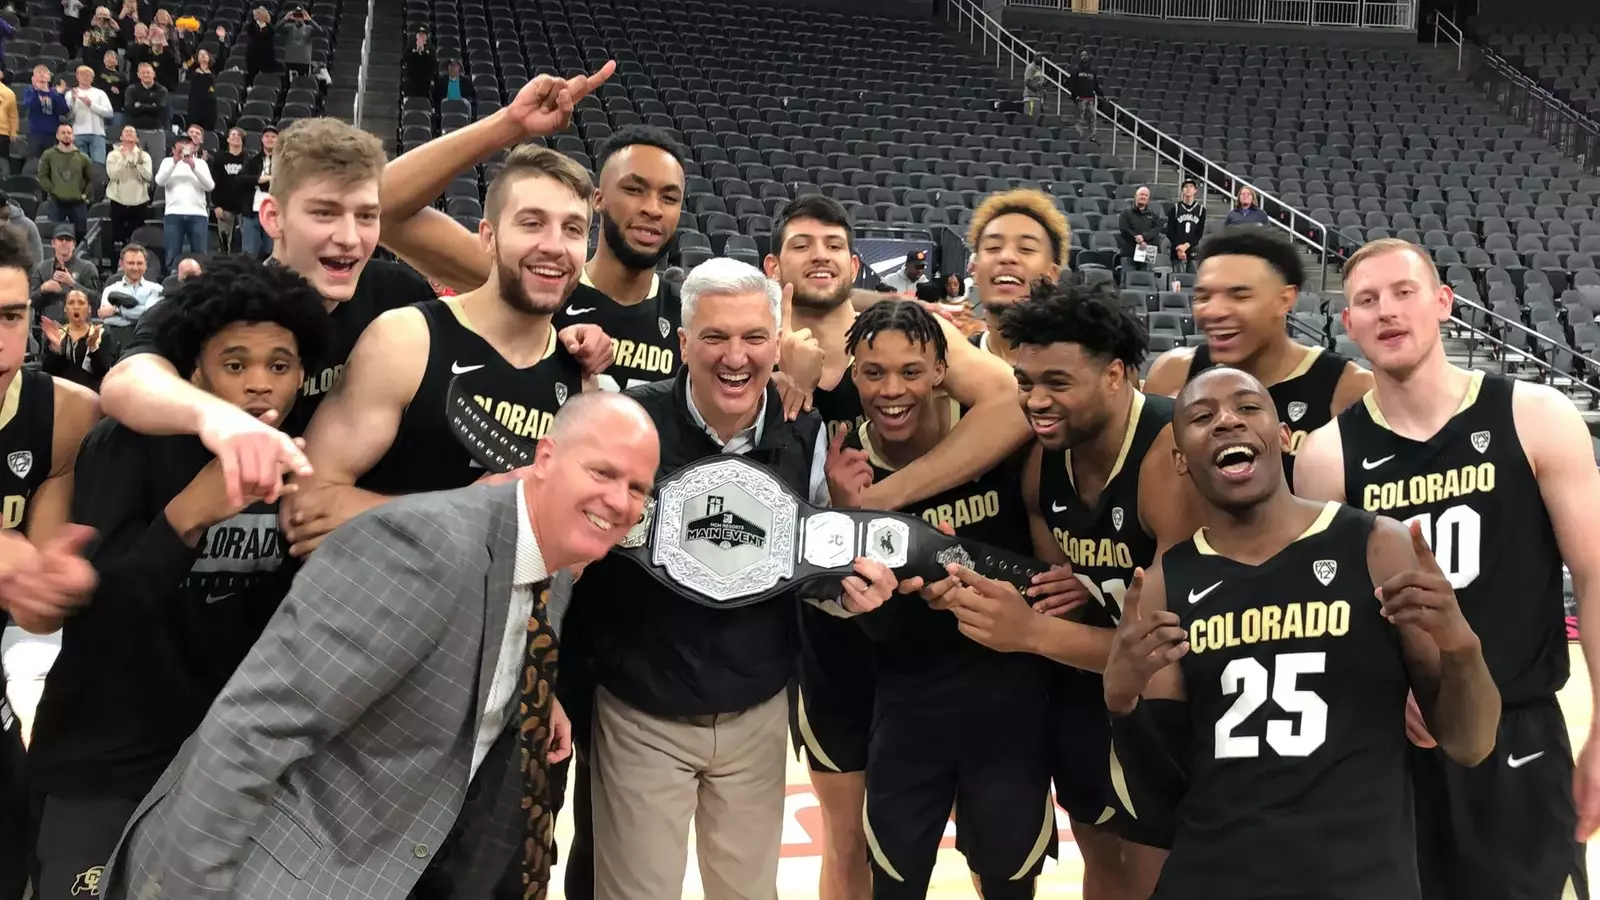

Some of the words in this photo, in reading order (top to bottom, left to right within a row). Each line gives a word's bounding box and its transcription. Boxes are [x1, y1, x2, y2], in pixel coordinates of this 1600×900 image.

[1363, 462, 1495, 512] COLORADO
[686, 528, 721, 541] MAIN
[722, 529, 766, 549] EVENT
[1315, 561, 1337, 575] PAC
[1319, 570, 1331, 580] 12
[1190, 600, 1351, 655] COLORADO
[1214, 651, 1329, 760] 25
